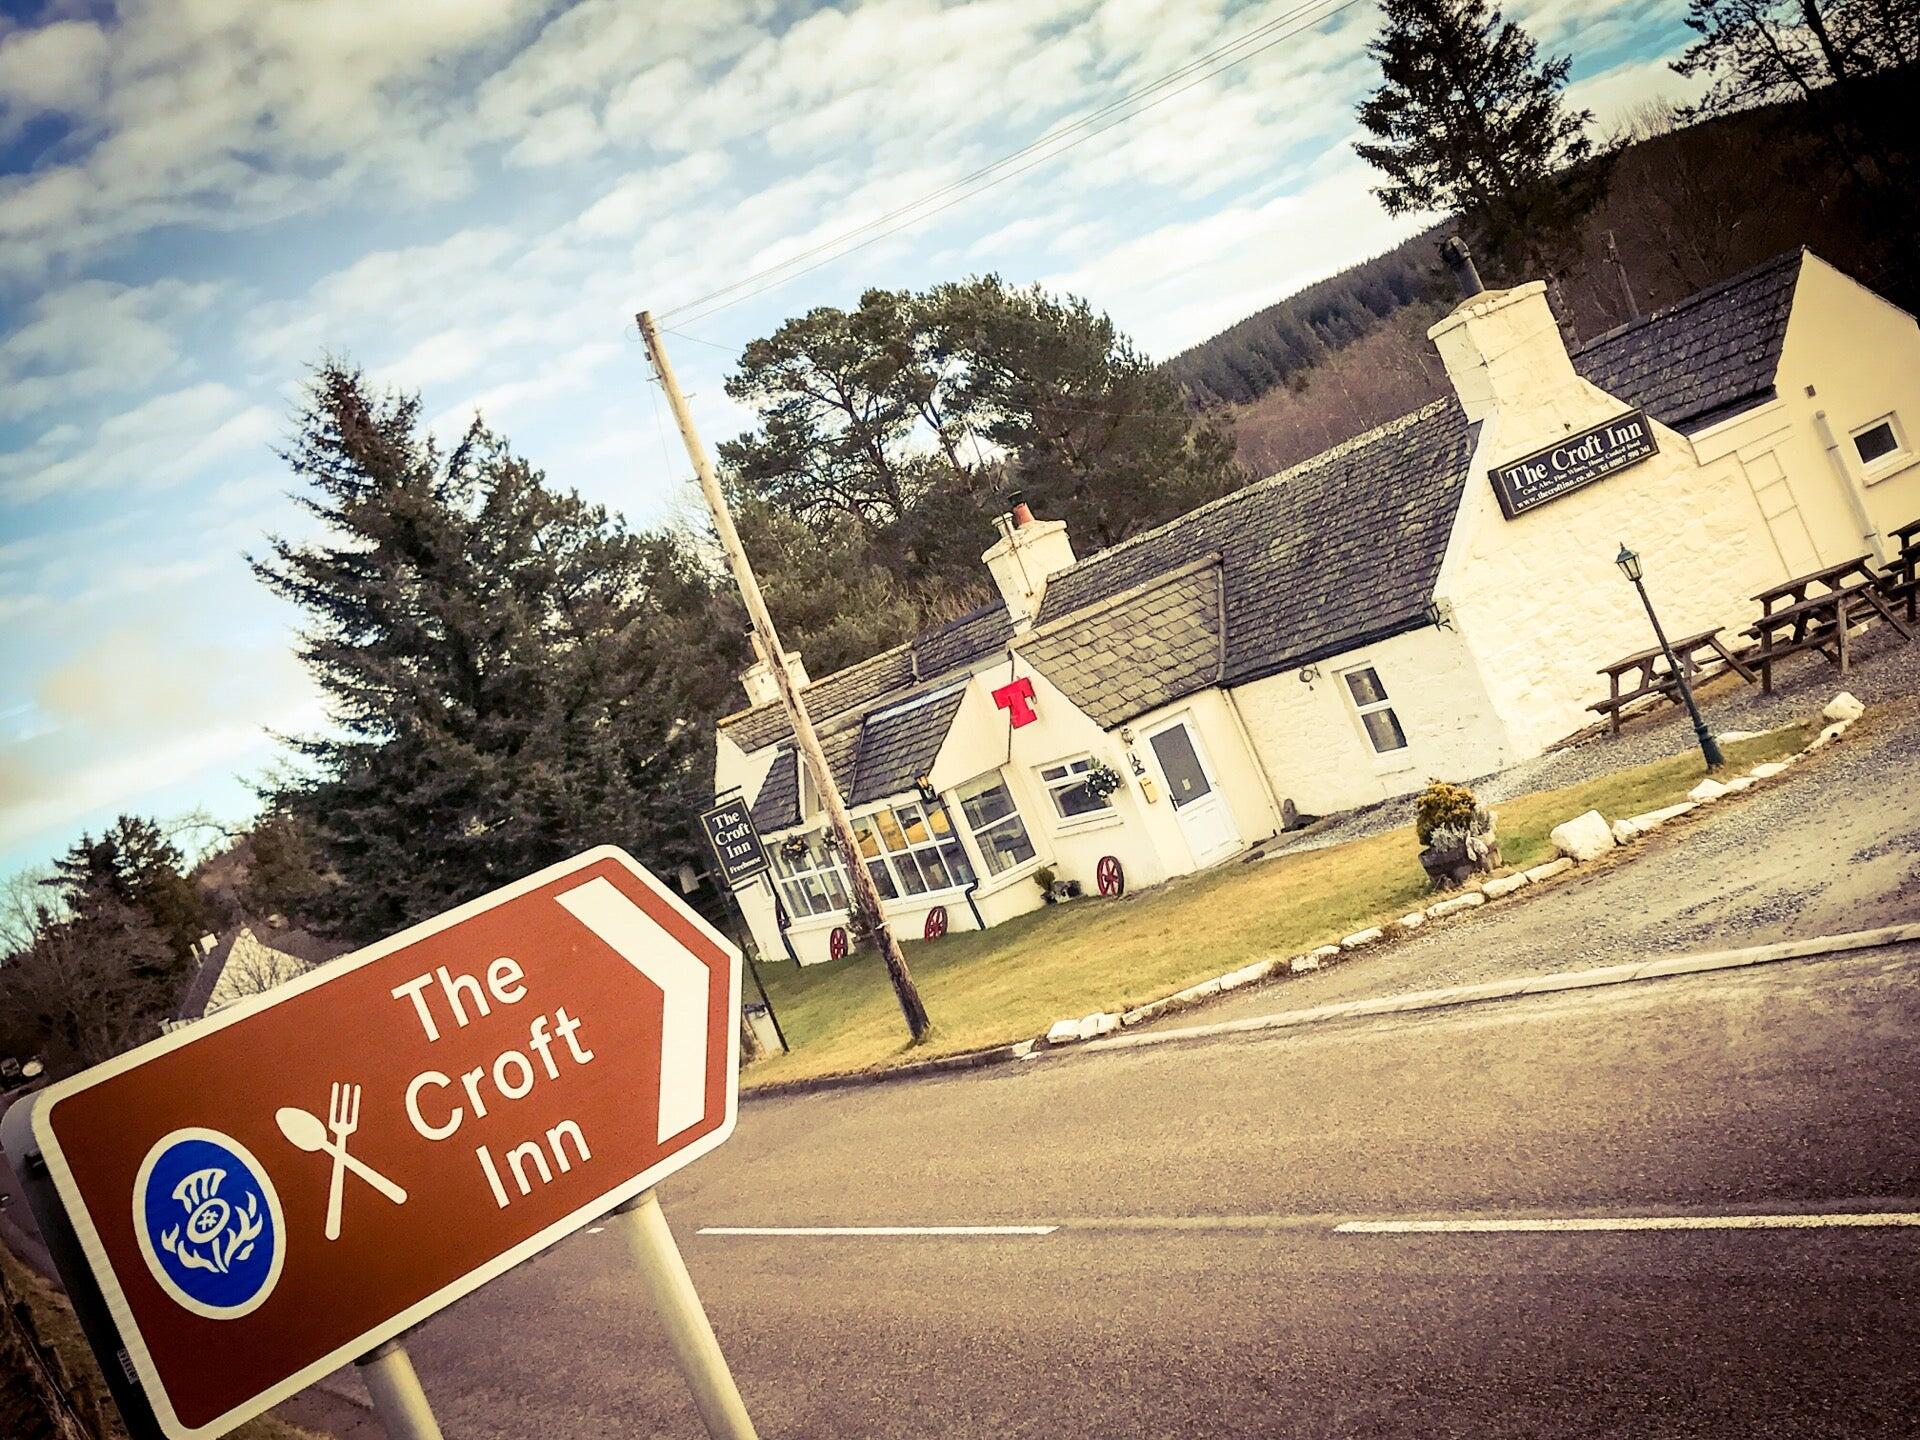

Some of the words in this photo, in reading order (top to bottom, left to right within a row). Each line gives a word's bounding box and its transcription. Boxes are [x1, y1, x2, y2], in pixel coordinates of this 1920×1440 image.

[1506, 463, 1548, 490] The
[1551, 435, 1604, 471] Croft
[1605, 422, 1643, 449] Inn
[1517, 469, 1596, 508] www.thecroftinn.co.uk
[712, 812, 740, 829] The
[714, 823, 751, 846] Croft
[726, 841, 752, 859] Inn
[729, 856, 761, 874] Freehouse
[390, 956, 528, 1043] The
[405, 1006, 595, 1141] Croft
[475, 1119, 592, 1209] Inn
